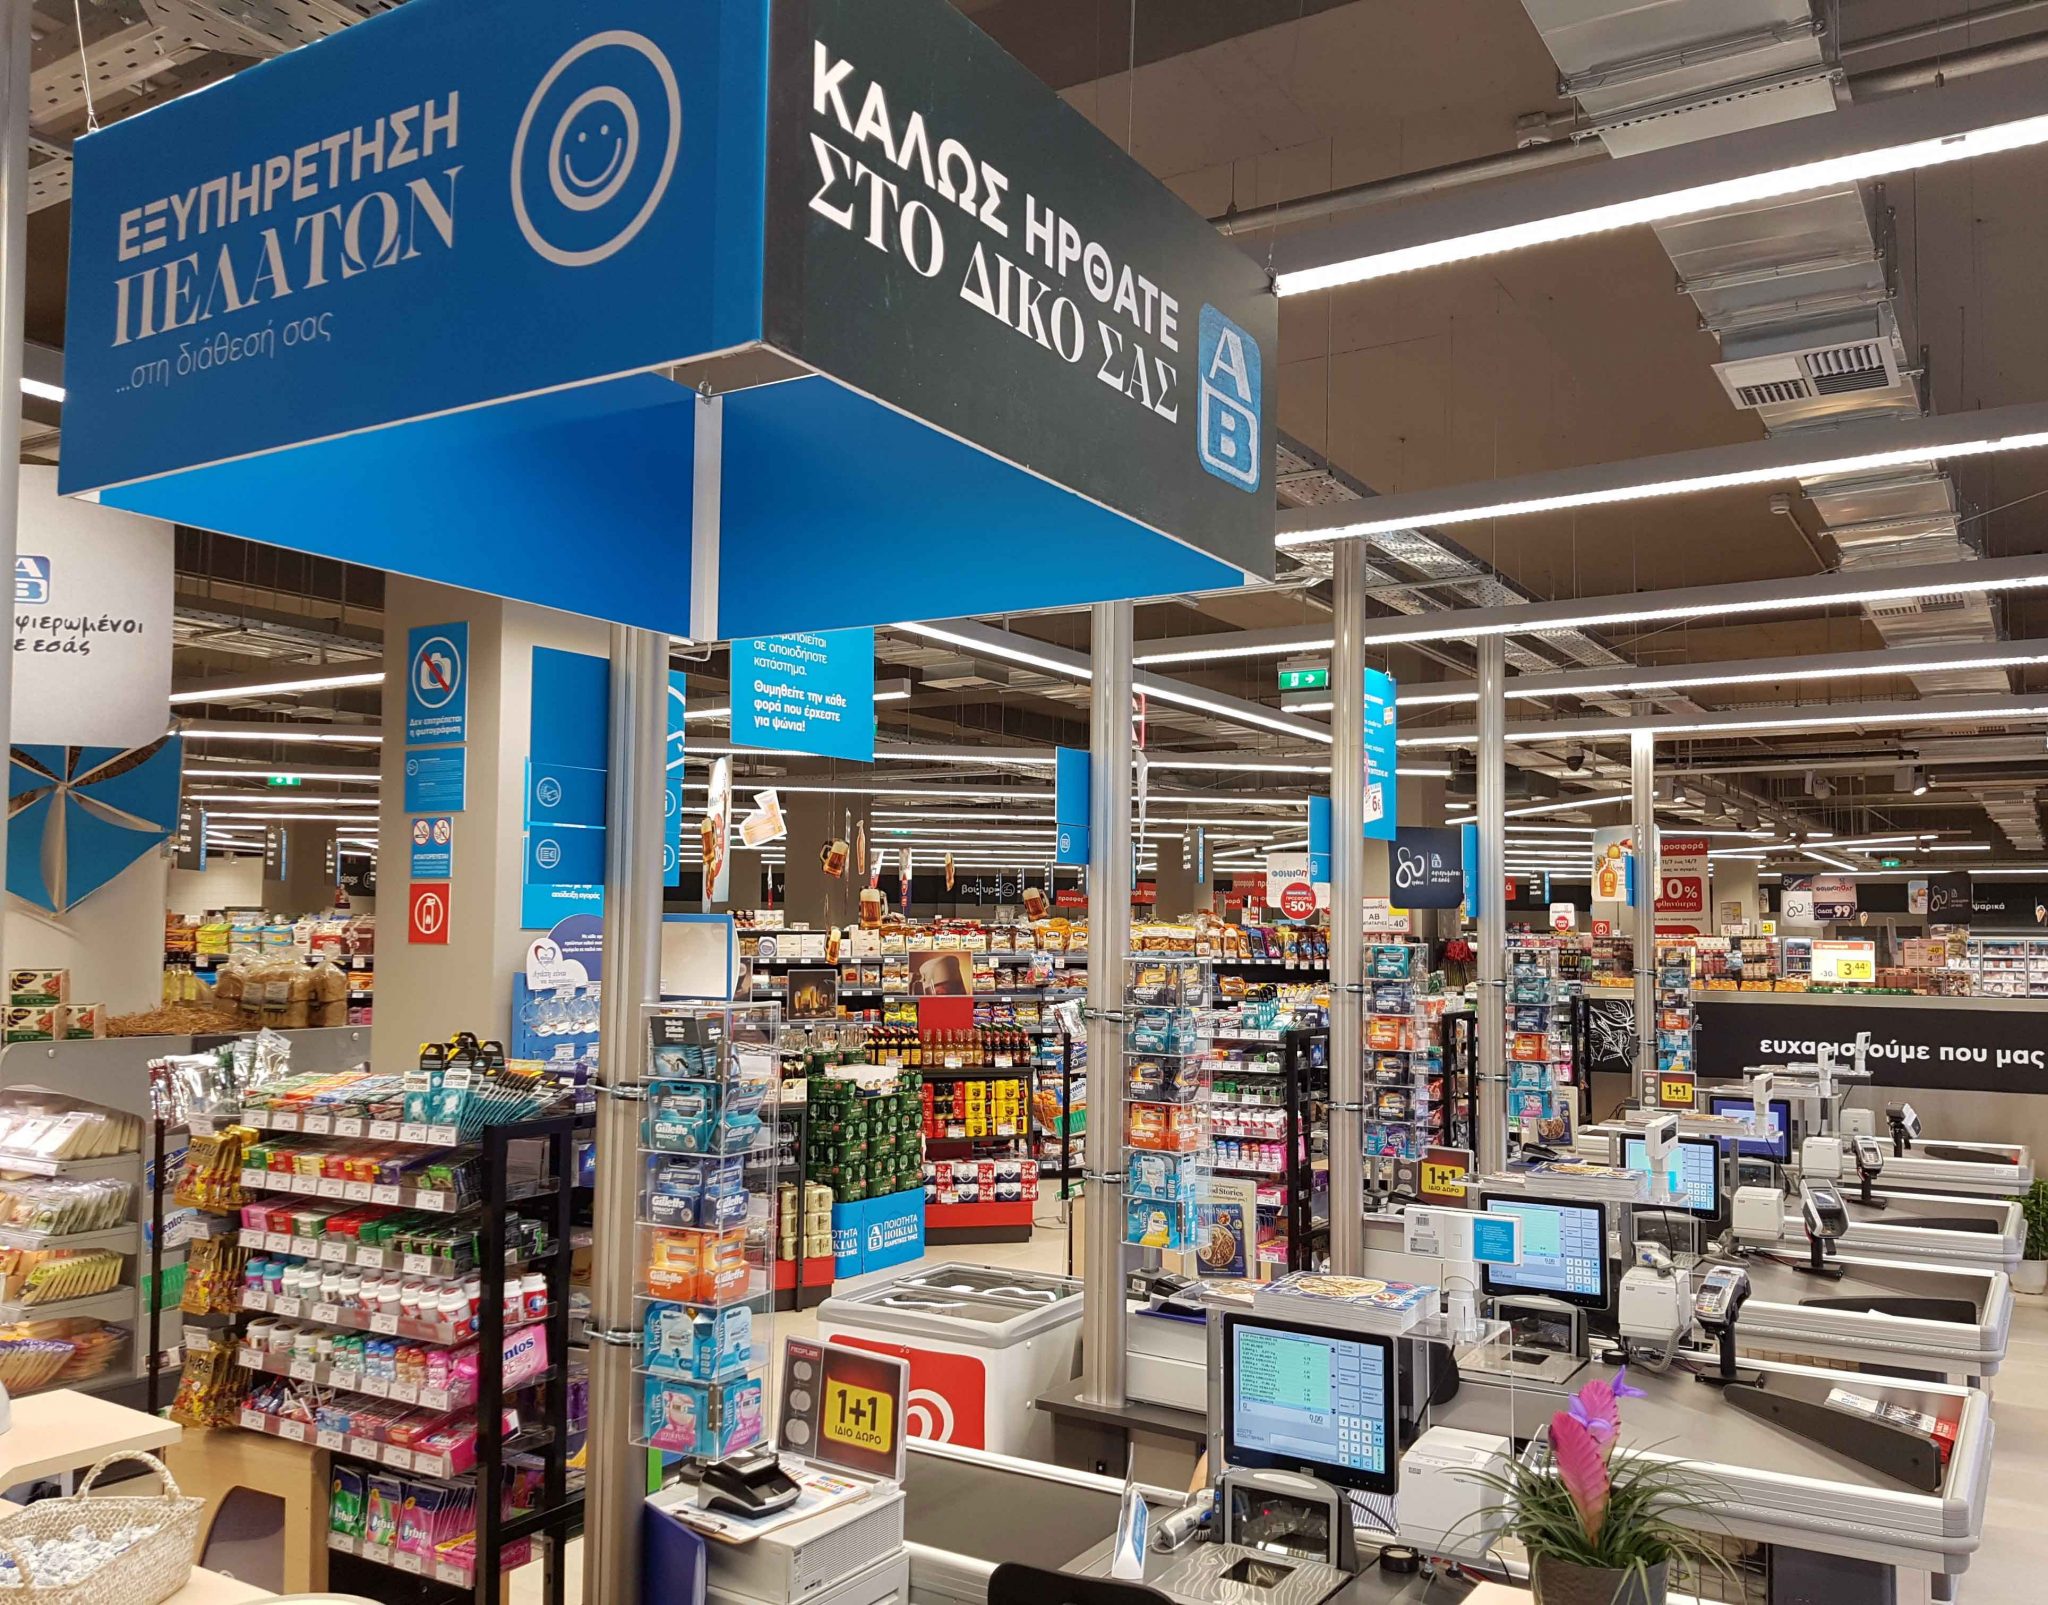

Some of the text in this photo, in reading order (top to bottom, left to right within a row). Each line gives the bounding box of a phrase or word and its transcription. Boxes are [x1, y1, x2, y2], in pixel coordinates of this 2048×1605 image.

[118, 91, 460, 262] ΕΞΥΠΗΡΕΤΗΣΗ
[813, 40, 1179, 353] ΚΑΛΩΣ ΗΡΘΑΤΕ
[111, 165, 464, 347] ΠΕΛΑΤΩΝ
[808, 132, 1178, 424] ΣΤΟ ΔΙΚΟ ΣΑΣ
[175, 320, 275, 378] διάθεσή
[283, 311, 334, 353] σας
[15, 614, 143, 638] φιερωμένοι
[14, 636, 90, 656] ε εσάς
[754, 640, 828, 664] σε οποιοδήποτε
[754, 657, 807, 676] κατάστημα.
[754, 680, 847, 708] Θυμηθείτε την κάθε
[754, 699, 841, 722] φορά που έρχεστε
[754, 715, 806, 732] για ψώνια!
[340, 874, 358, 886] sings
[1760, 1038, 2045, 1069] ευχαισούμε που μας
[1667, 1084, 1686, 1096] 1+1
[655, 1123, 688, 1135] Gillette
[1429, 1167, 1456, 1187] 1+1
[652, 1196, 685, 1208] Gillette
[884, 1214, 918, 1230] ΠΟΙΟΤΗΤΑ
[832, 1228, 858, 1239] ΟΤΗΤΑ
[833, 1238, 857, 1249] ΚΙΛΙΑ
[650, 1270, 683, 1284] Gillette
[503, 1336, 534, 1361] ntos
[837, 1389, 878, 1431] 1+1
[835, 1425, 882, 1445] ΙΔΙΟ ΔΩΡΟ
